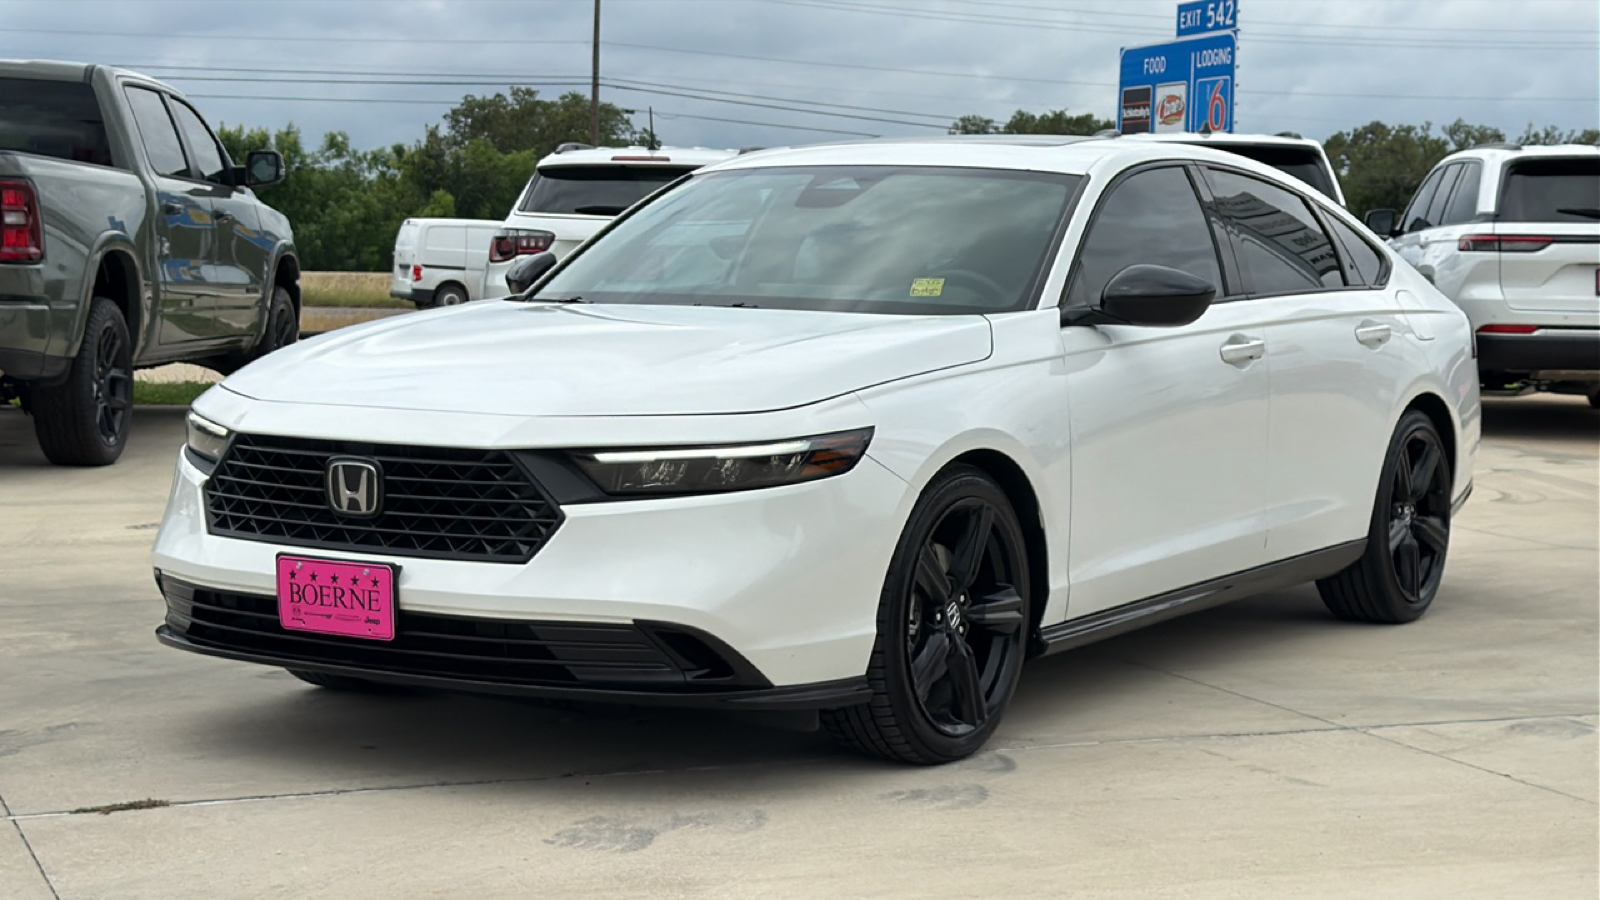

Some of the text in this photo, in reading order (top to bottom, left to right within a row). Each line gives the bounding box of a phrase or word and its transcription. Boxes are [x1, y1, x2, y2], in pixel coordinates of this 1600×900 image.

[1180, 1, 1234, 29] EXIT 542
[1143, 55, 1166, 75] FOOD
[1196, 46, 1232, 69] LODGING
[1209, 79, 1225, 131] 6
[289, 581, 381, 612] BOERNE
